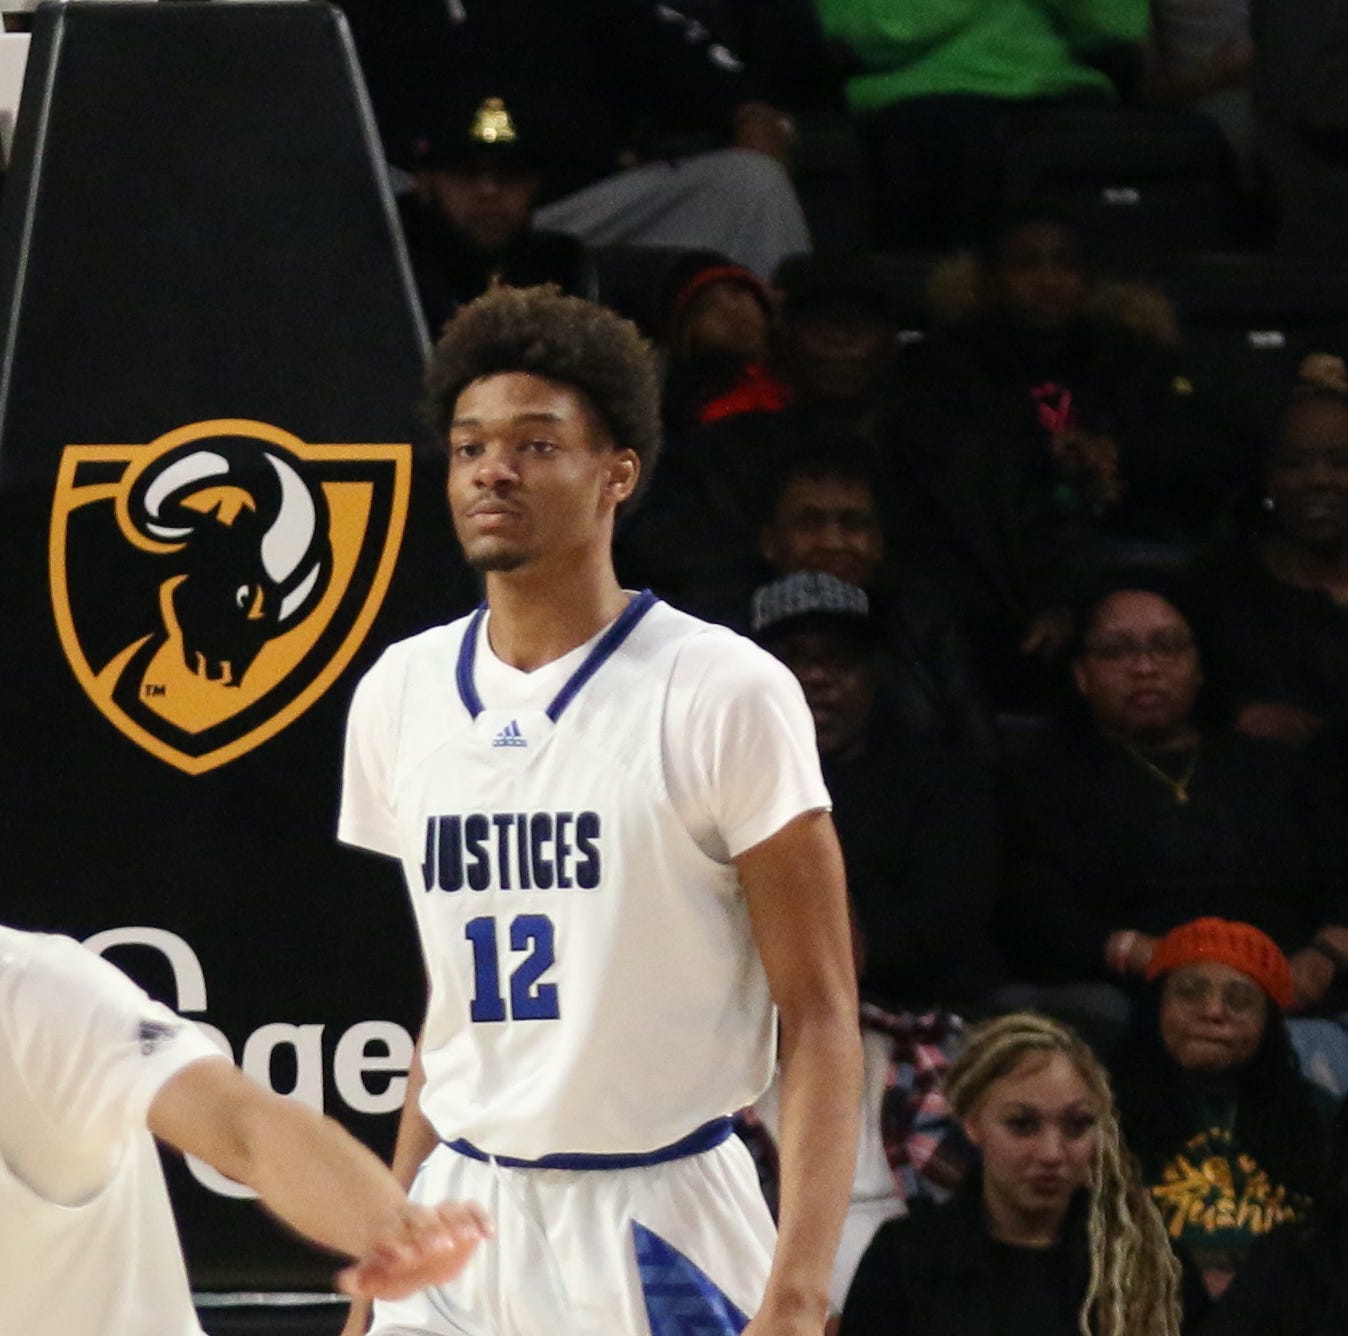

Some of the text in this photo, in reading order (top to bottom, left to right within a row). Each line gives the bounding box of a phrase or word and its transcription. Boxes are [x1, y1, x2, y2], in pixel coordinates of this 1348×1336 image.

[145, 684, 166, 697] TM
[421, 811, 601, 893] JUSTICES
[465, 913, 561, 1023] 12
